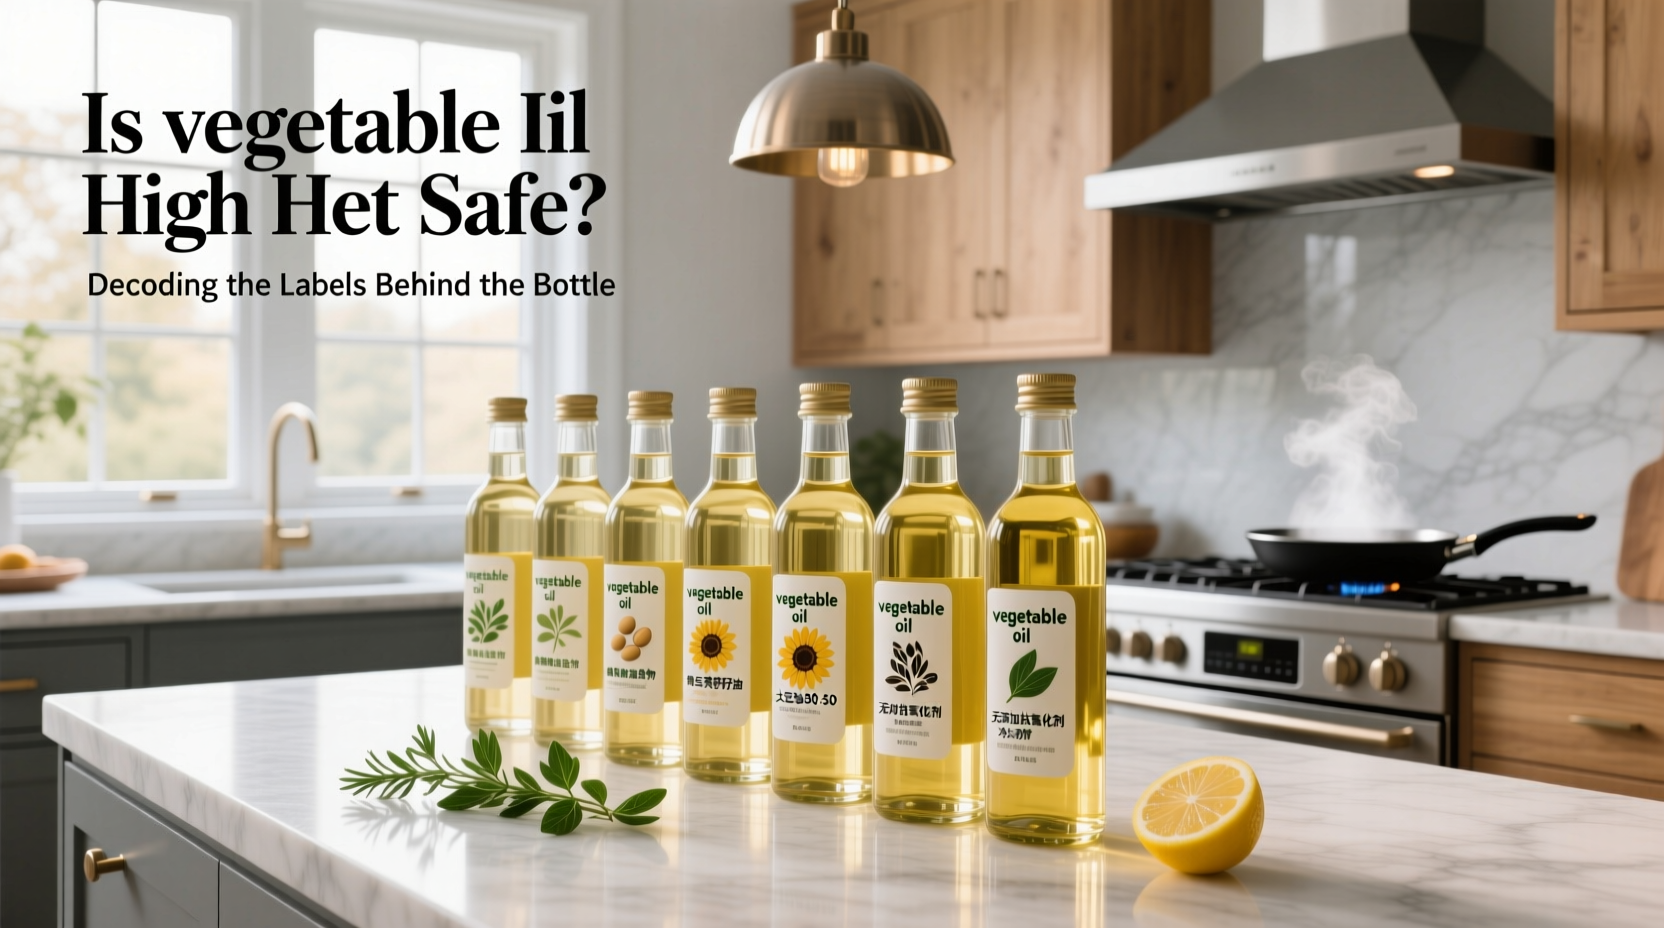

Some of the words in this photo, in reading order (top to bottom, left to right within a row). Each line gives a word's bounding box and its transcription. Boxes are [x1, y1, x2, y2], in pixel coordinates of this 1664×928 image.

[619, 596, 632, 610] oil
[776, 591, 838, 609] vegetable
[878, 599, 945, 617] vegetable
[792, 609, 808, 623] oil
[992, 607, 1067, 628] vegetable
[895, 617, 912, 633] oil
[1012, 627, 1031, 643] oil
